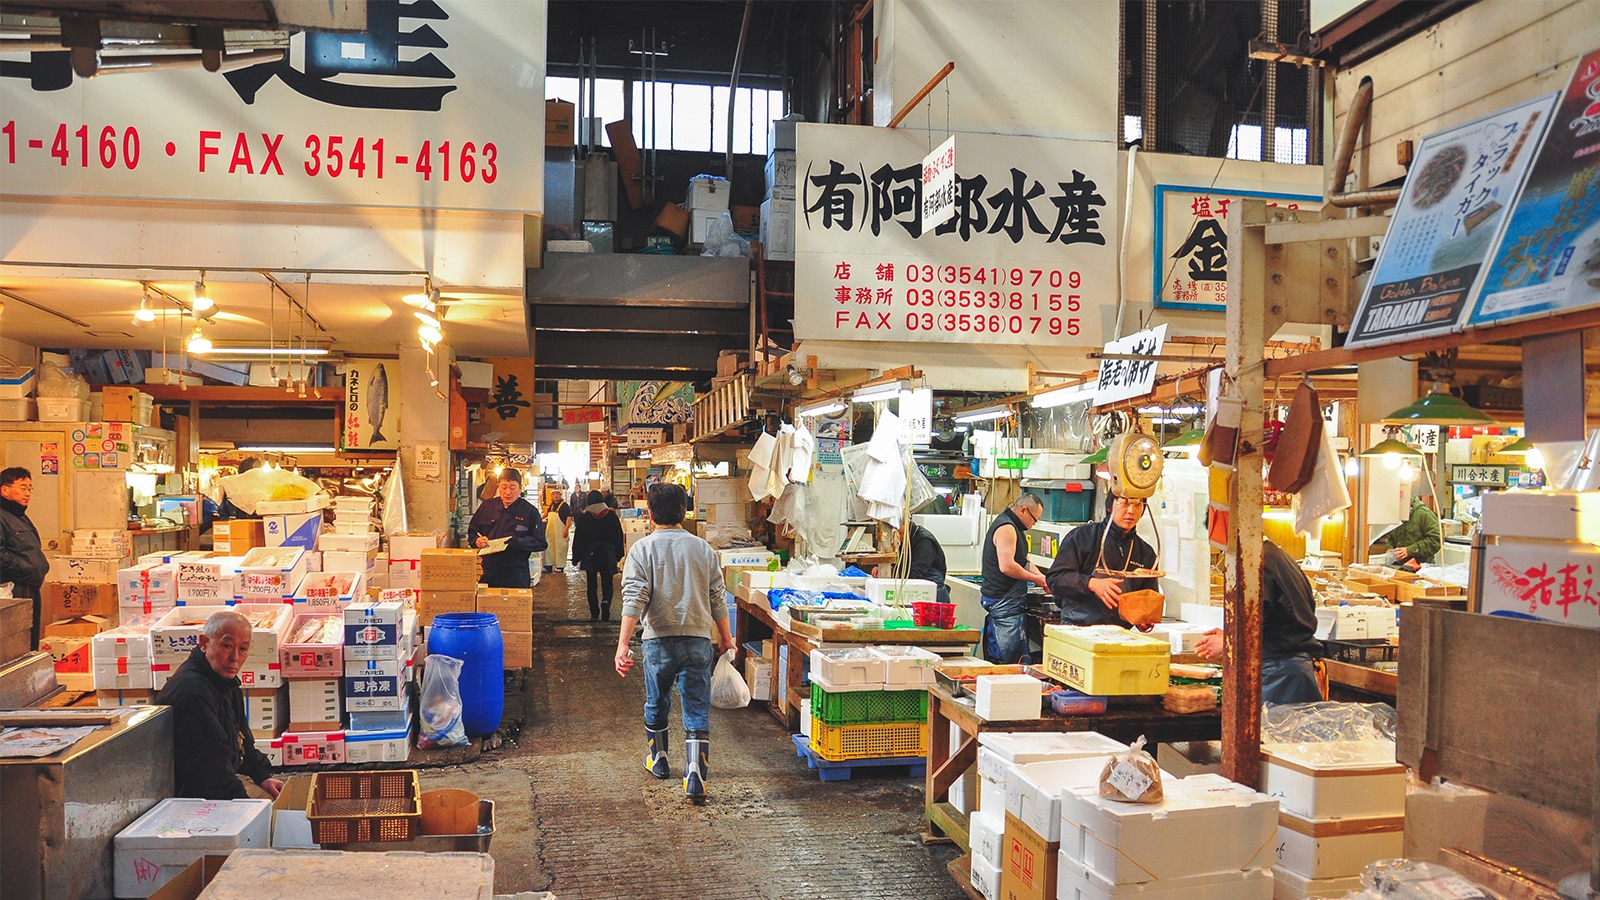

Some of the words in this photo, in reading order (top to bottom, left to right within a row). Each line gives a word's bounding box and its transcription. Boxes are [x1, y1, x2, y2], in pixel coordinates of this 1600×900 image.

[198, 130, 285, 176] FAX
[303, 134, 499, 184] 3541-4163
[833, 285, 894, 306] 事務所
[835, 310, 892, 330] FAX
[1362, 298, 1432, 333] TARAKAN
[487, 373, 532, 421] 善
[1457, 466, 1500, 483] 川合水産
[353, 680, 391, 693] 要冷凍
